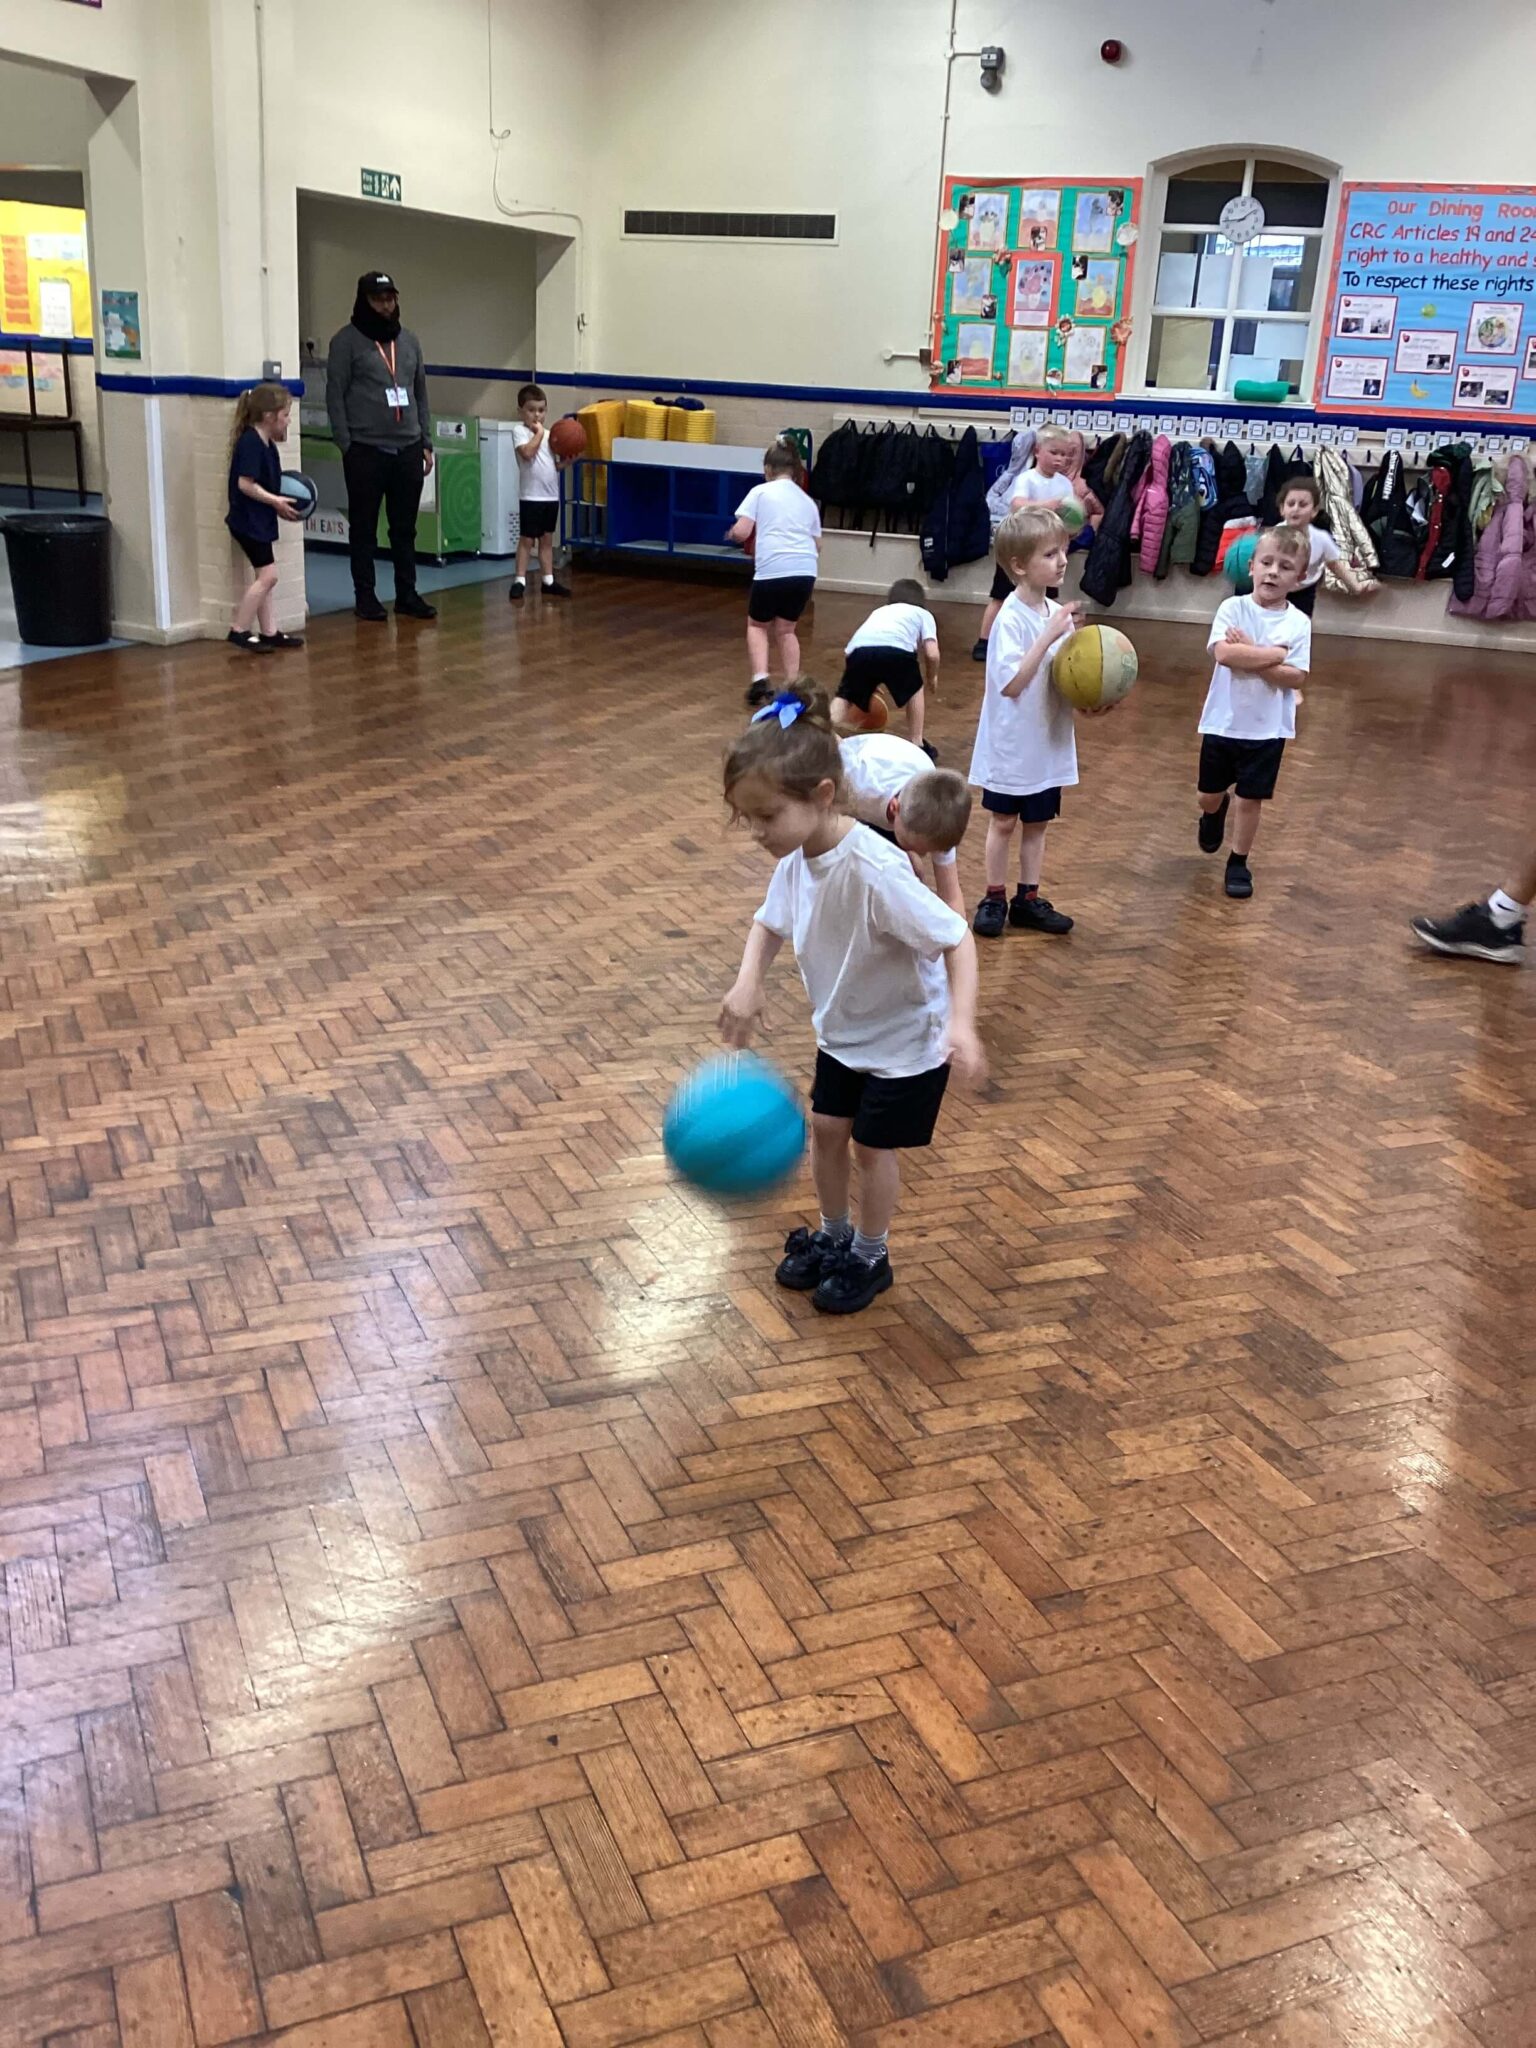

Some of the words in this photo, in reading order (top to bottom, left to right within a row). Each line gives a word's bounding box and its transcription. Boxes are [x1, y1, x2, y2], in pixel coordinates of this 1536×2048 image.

[1388, 200, 1417, 215] Our
[1429, 198, 1483, 222] Dining
[1498, 203, 1536, 218] Roo
[1350, 222, 1386, 238] CRC
[1391, 224, 1460, 241] Articles
[1464, 225, 1481, 242] 19
[1485, 225, 1516, 243] and
[1348, 245, 1388, 268] right
[1393, 248, 1410, 264] to
[1414, 251, 1424, 264] a
[1430, 247, 1493, 272] healthy
[1497, 250, 1529, 268] and
[1342, 271, 1360, 287] To
[1366, 275, 1428, 293] respect
[1432, 273, 1480, 291] these
[1485, 274, 1534, 297] rights
